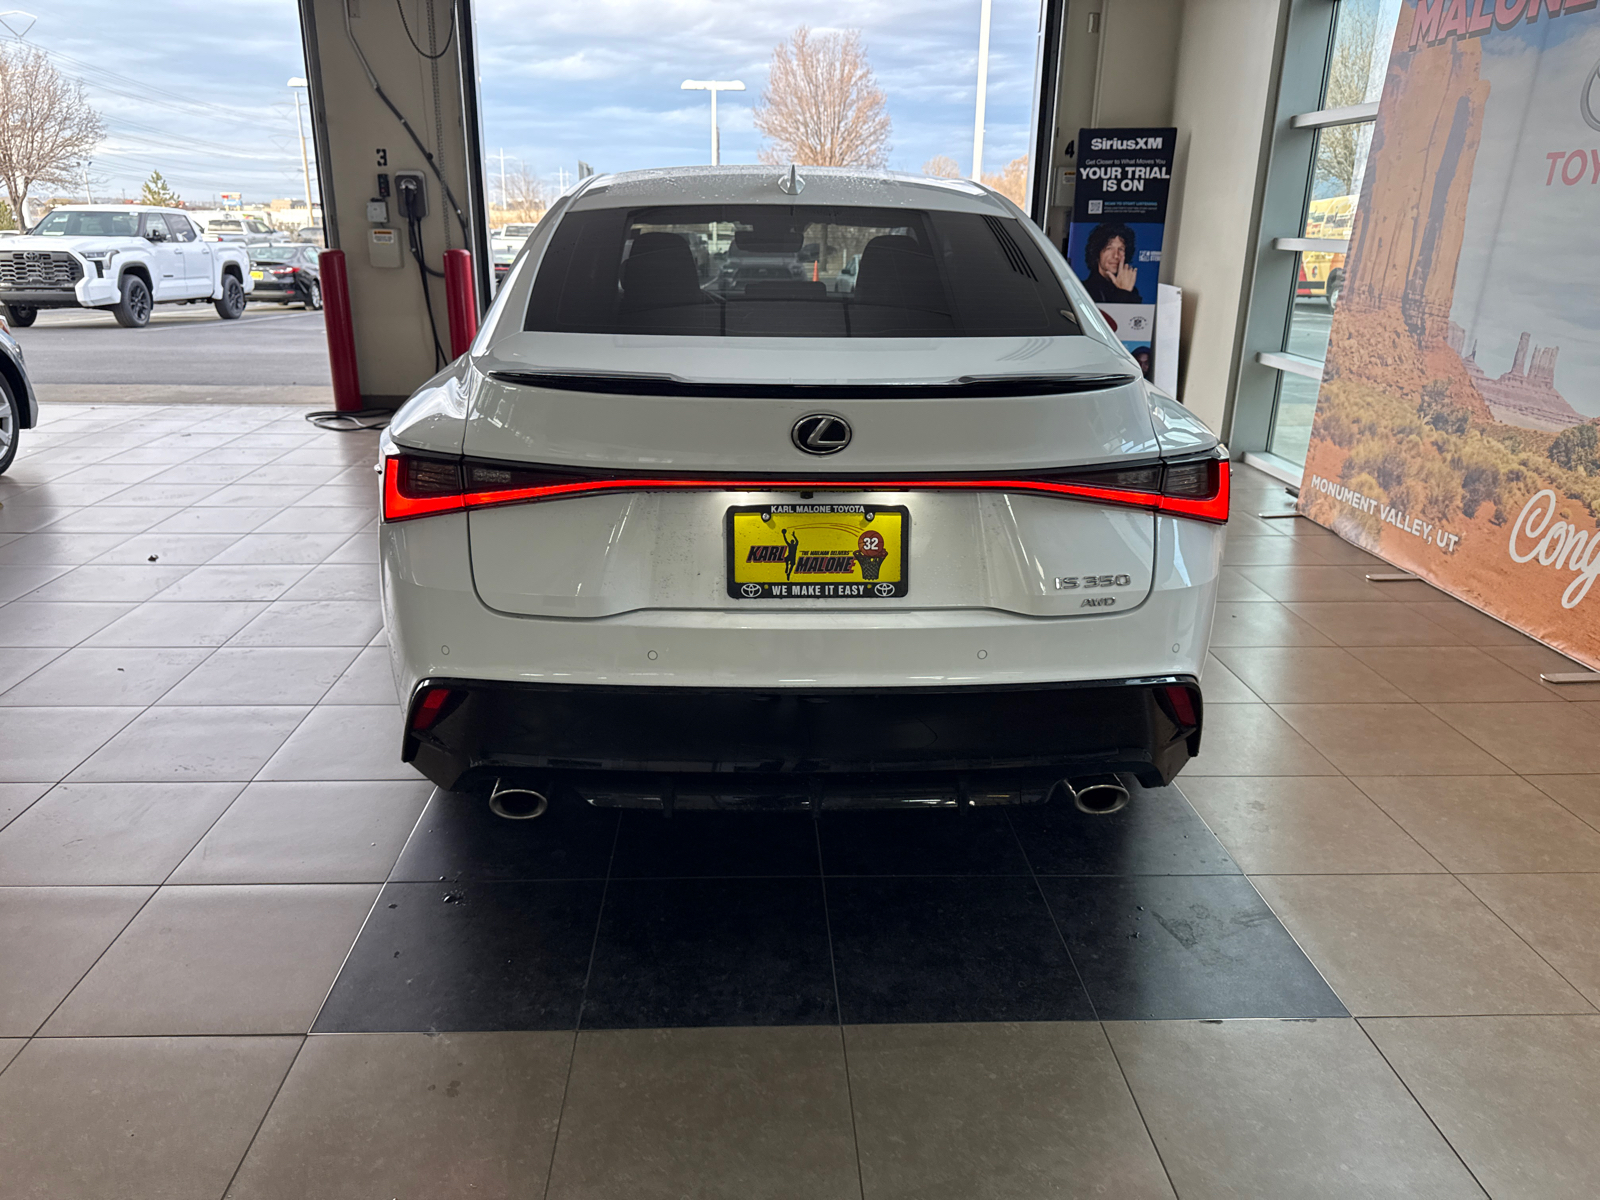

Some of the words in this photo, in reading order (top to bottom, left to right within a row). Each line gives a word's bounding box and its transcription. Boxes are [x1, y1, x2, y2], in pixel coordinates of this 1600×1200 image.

[1064, 140, 1075, 158] 4
[1090, 137, 1163, 150] SiriusXM
[376, 148, 388, 166] 3
[1079, 167, 1122, 180] YOUR
[1125, 166, 1170, 179] TRIAL
[1102, 179, 1118, 192] IS
[1120, 179, 1144, 191] ON
[771, 505, 794, 513] KARL
[796, 505, 831, 513] MALONE
[833, 505, 865, 513] TOYOTA
[1311, 474, 1378, 515] MONUMENT
[1380, 504, 1432, 545] VALLEY,
[1436, 529, 1459, 552] UT
[863, 537, 879, 550] 32
[746, 545, 788, 563] KARL
[794, 556, 856, 574] MALONE
[1055, 577, 1080, 590] IS
[1083, 573, 1131, 589] 350
[772, 585, 788, 596] WE
[792, 585, 821, 596] MAKE
[825, 585, 834, 596] IT
[838, 585, 865, 596] EASY
[1080, 596, 1117, 608] AWD
